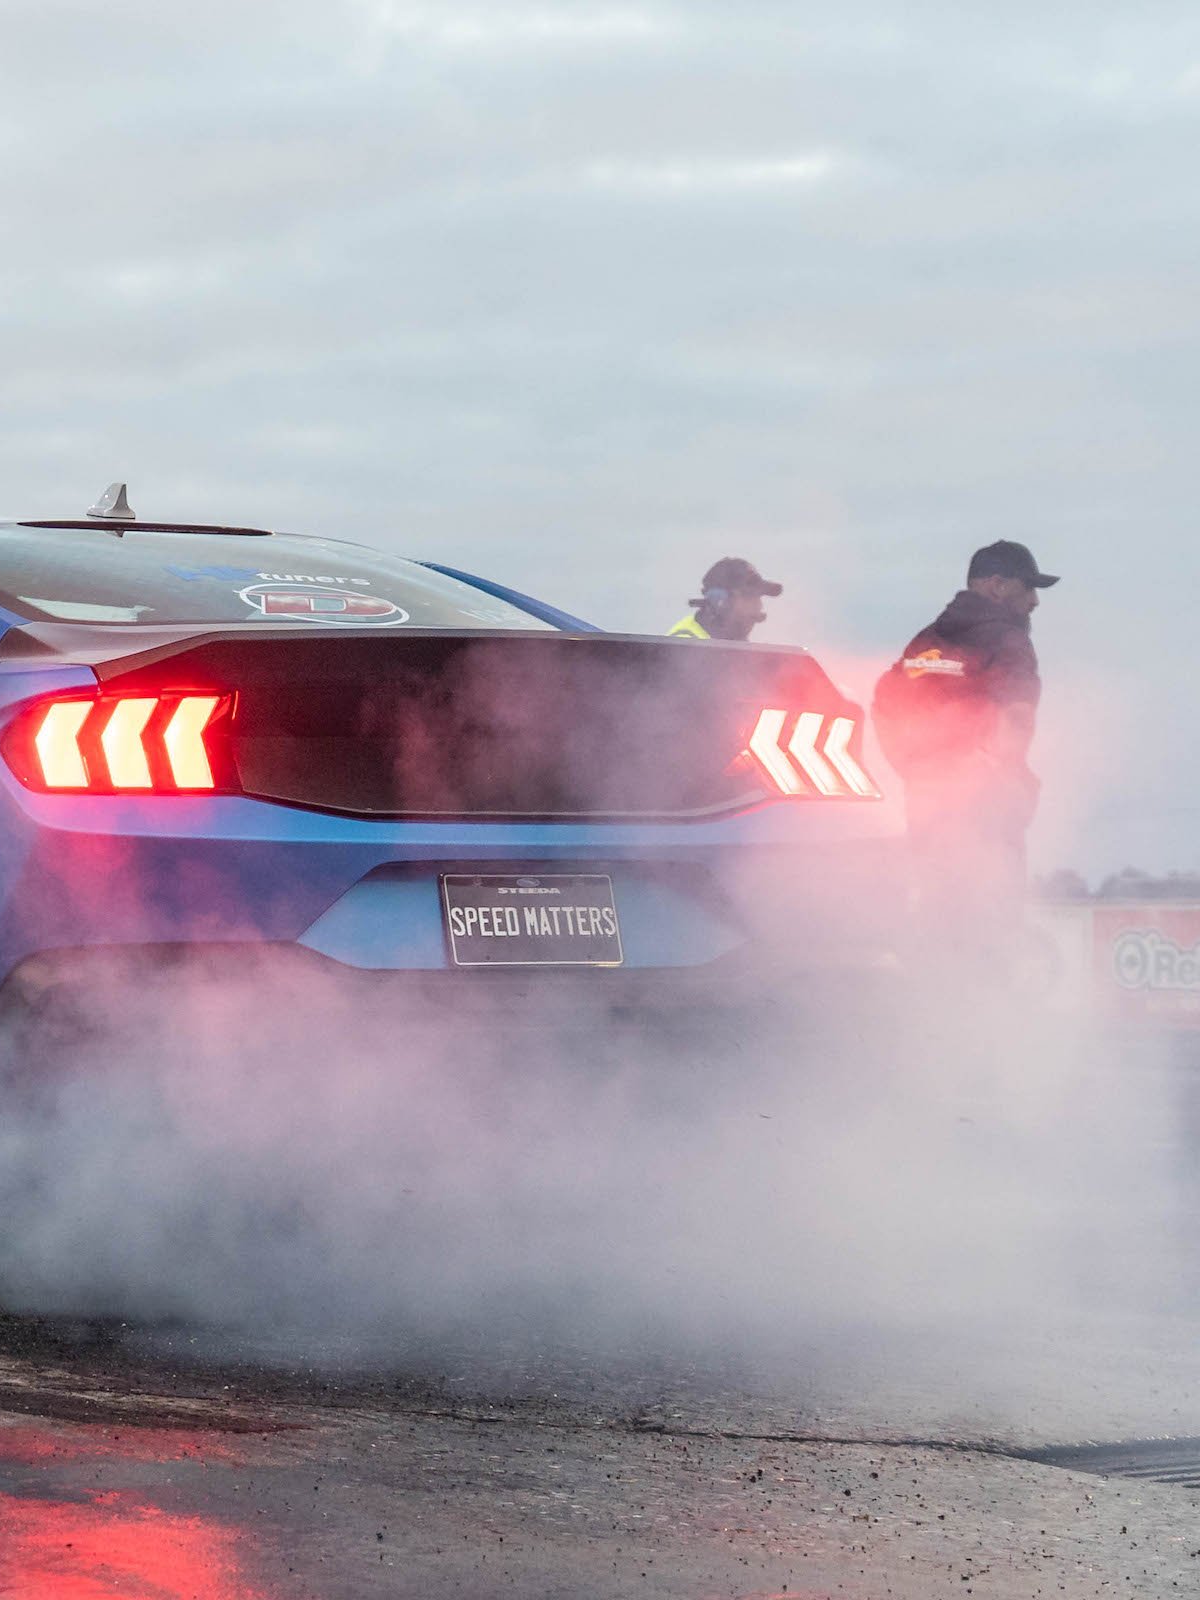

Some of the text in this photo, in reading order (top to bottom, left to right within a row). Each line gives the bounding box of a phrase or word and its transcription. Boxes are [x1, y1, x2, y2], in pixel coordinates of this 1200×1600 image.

[256, 572, 370, 586] tuners
[498, 887, 561, 895] STEEDA
[451, 907, 617, 936] SPEED MATTERS
